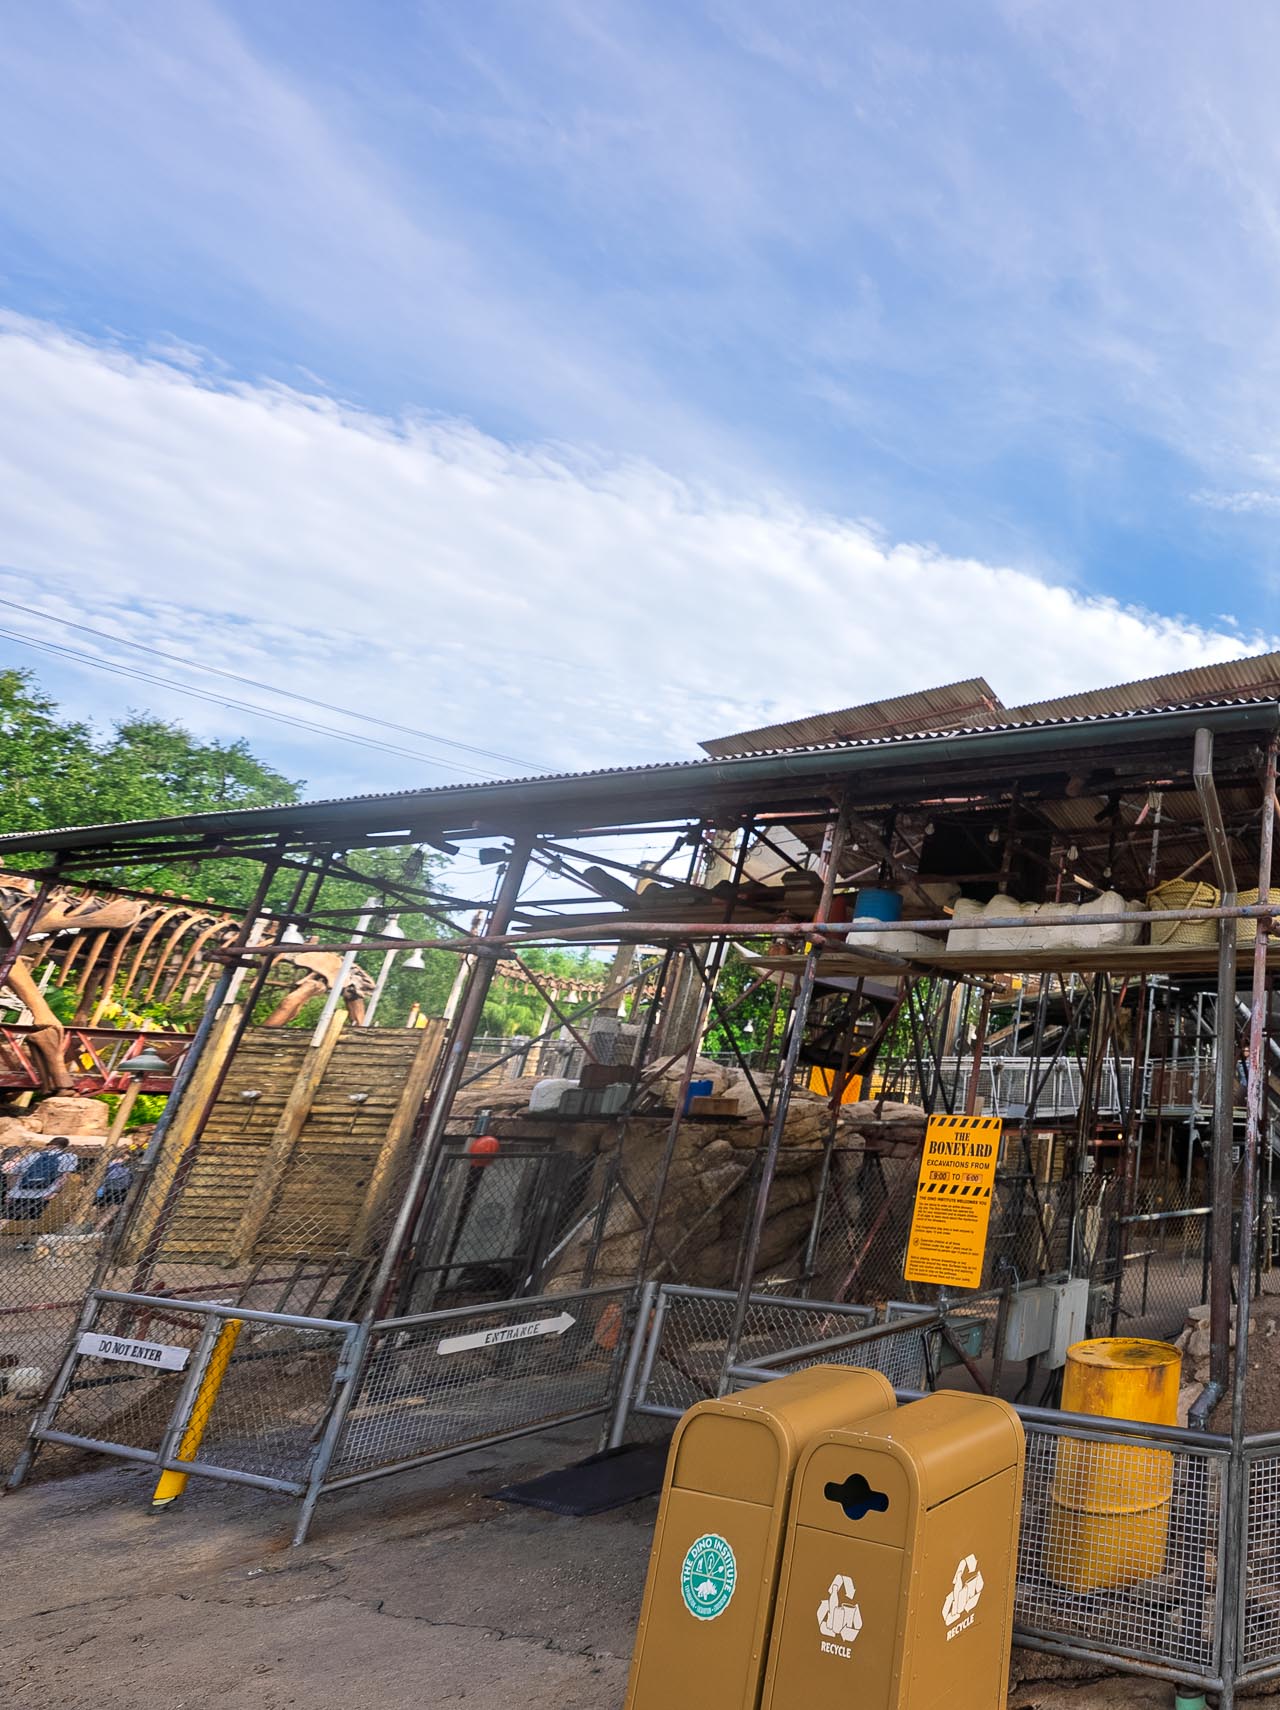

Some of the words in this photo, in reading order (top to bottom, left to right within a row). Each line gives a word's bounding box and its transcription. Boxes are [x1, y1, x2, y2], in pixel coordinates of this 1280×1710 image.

[955, 1132, 970, 1141] THE
[929, 1141, 992, 1157] BONEYARD
[927, 1159, 969, 1168] EXCAVATIONS
[484, 1323, 541, 1344] ENTRANCE
[98, 1340, 112, 1353] DO
[113, 1342, 131, 1357] NOT
[131, 1345, 163, 1362] ENTER
[683, 1558, 694, 1583] THE
[690, 1538, 713, 1559] DINO
[714, 1538, 734, 1593] INSTITUTE
[946, 1613, 975, 1642] RECYCLE
[820, 1640, 851, 1659] RECYCLE
